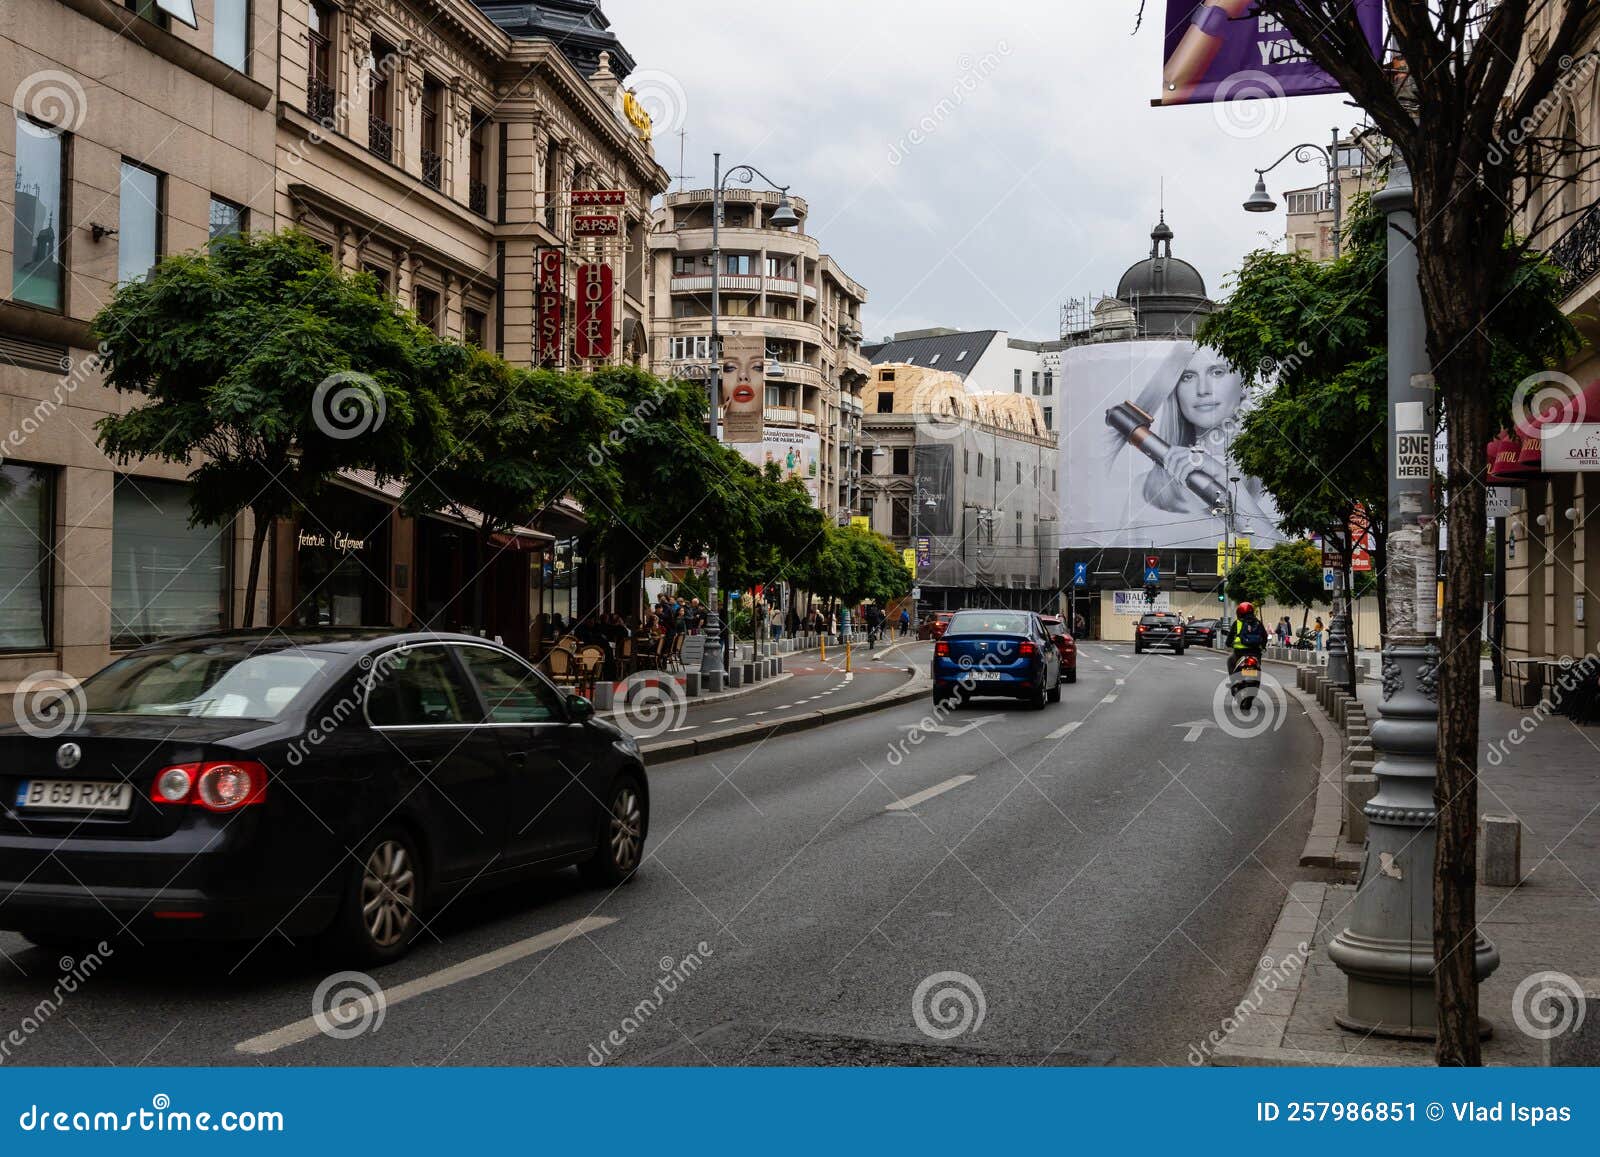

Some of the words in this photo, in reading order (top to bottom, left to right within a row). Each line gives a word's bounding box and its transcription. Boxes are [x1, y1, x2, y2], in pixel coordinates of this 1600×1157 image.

[586, 263, 603, 358] HOTEL
[1399, 436, 1429, 455] BNE
[1399, 455, 1429, 466] WAS
[1399, 467, 1429, 477] HERE
[30, 782, 44, 803] B
[49, 783, 73, 803] 69
